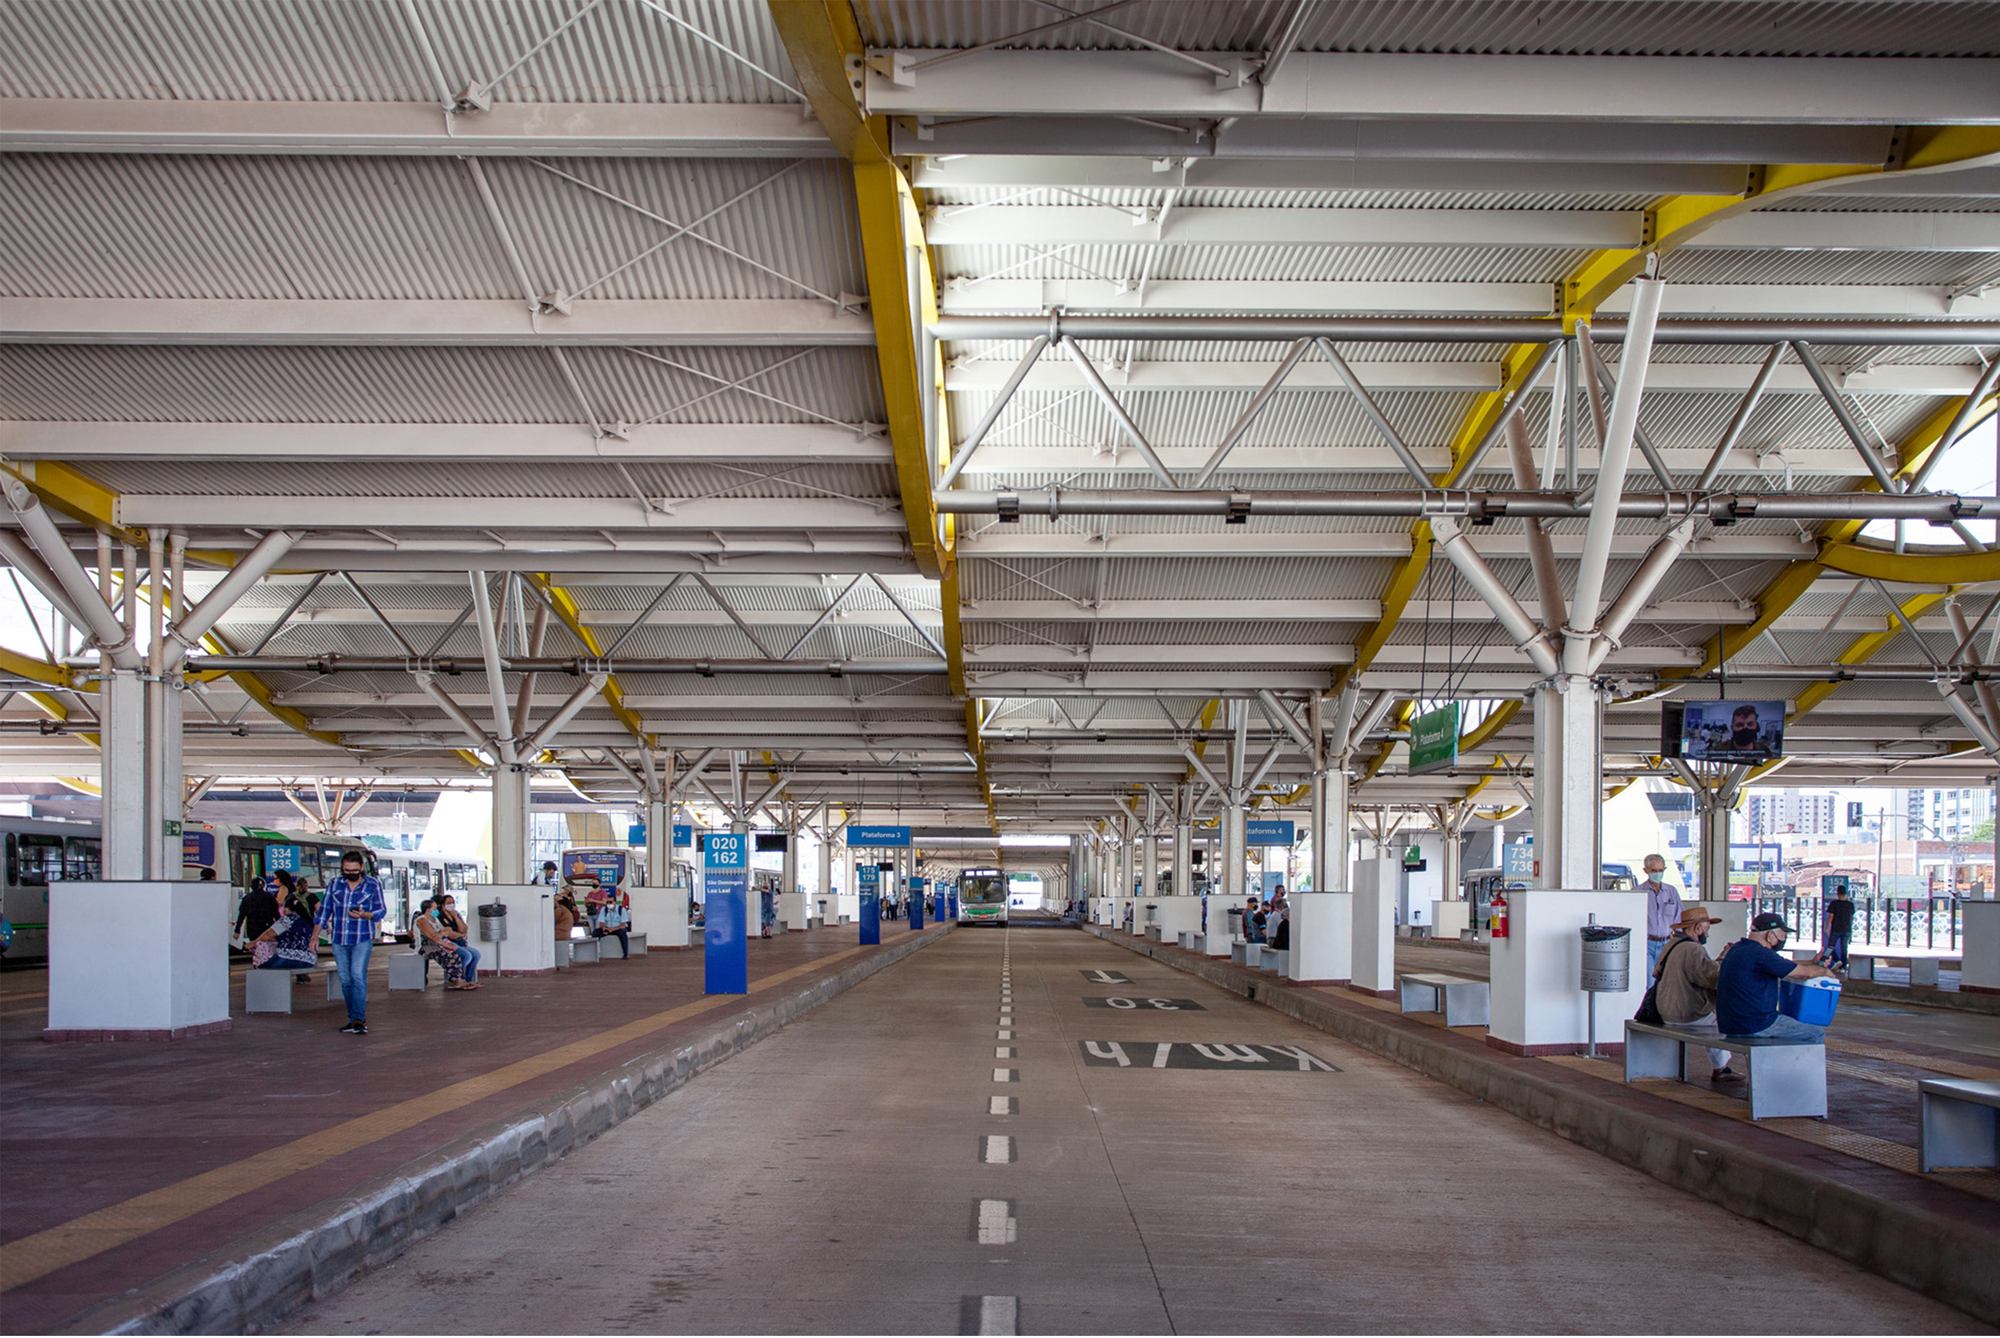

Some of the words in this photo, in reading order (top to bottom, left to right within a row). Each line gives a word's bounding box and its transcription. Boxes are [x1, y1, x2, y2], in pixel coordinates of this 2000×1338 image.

[711, 837, 738, 850] 020
[271, 848, 292, 858] 334
[712, 851, 738, 864] 162
[1510, 847, 1533, 859] 734
[271, 859, 292, 869] 335
[1510, 860, 1533, 872] 736
[1829, 877, 1844, 885] 152
[1105, 997, 1180, 1010] 30
